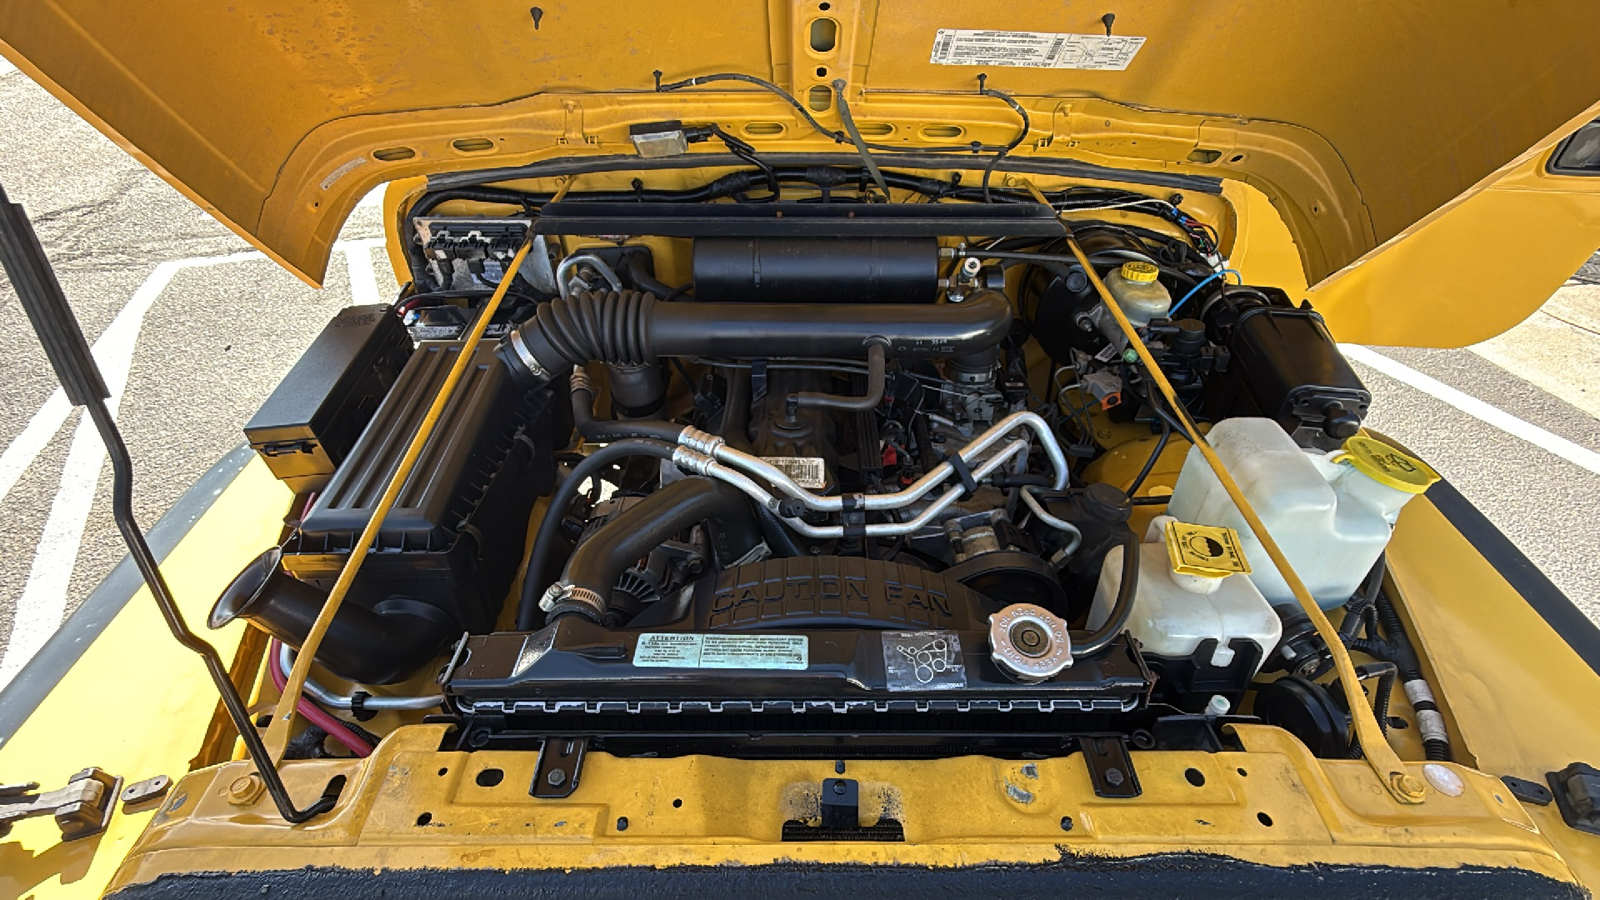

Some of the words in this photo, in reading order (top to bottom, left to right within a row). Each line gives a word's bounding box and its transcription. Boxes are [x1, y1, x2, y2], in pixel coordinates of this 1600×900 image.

[711, 580, 870, 613] CAUTION
[886, 584, 954, 617] FAN
[1011, 607, 1036, 617] OPEN
[1002, 646, 1029, 669] TIGHT
[1033, 655, 1059, 669] KEEP
